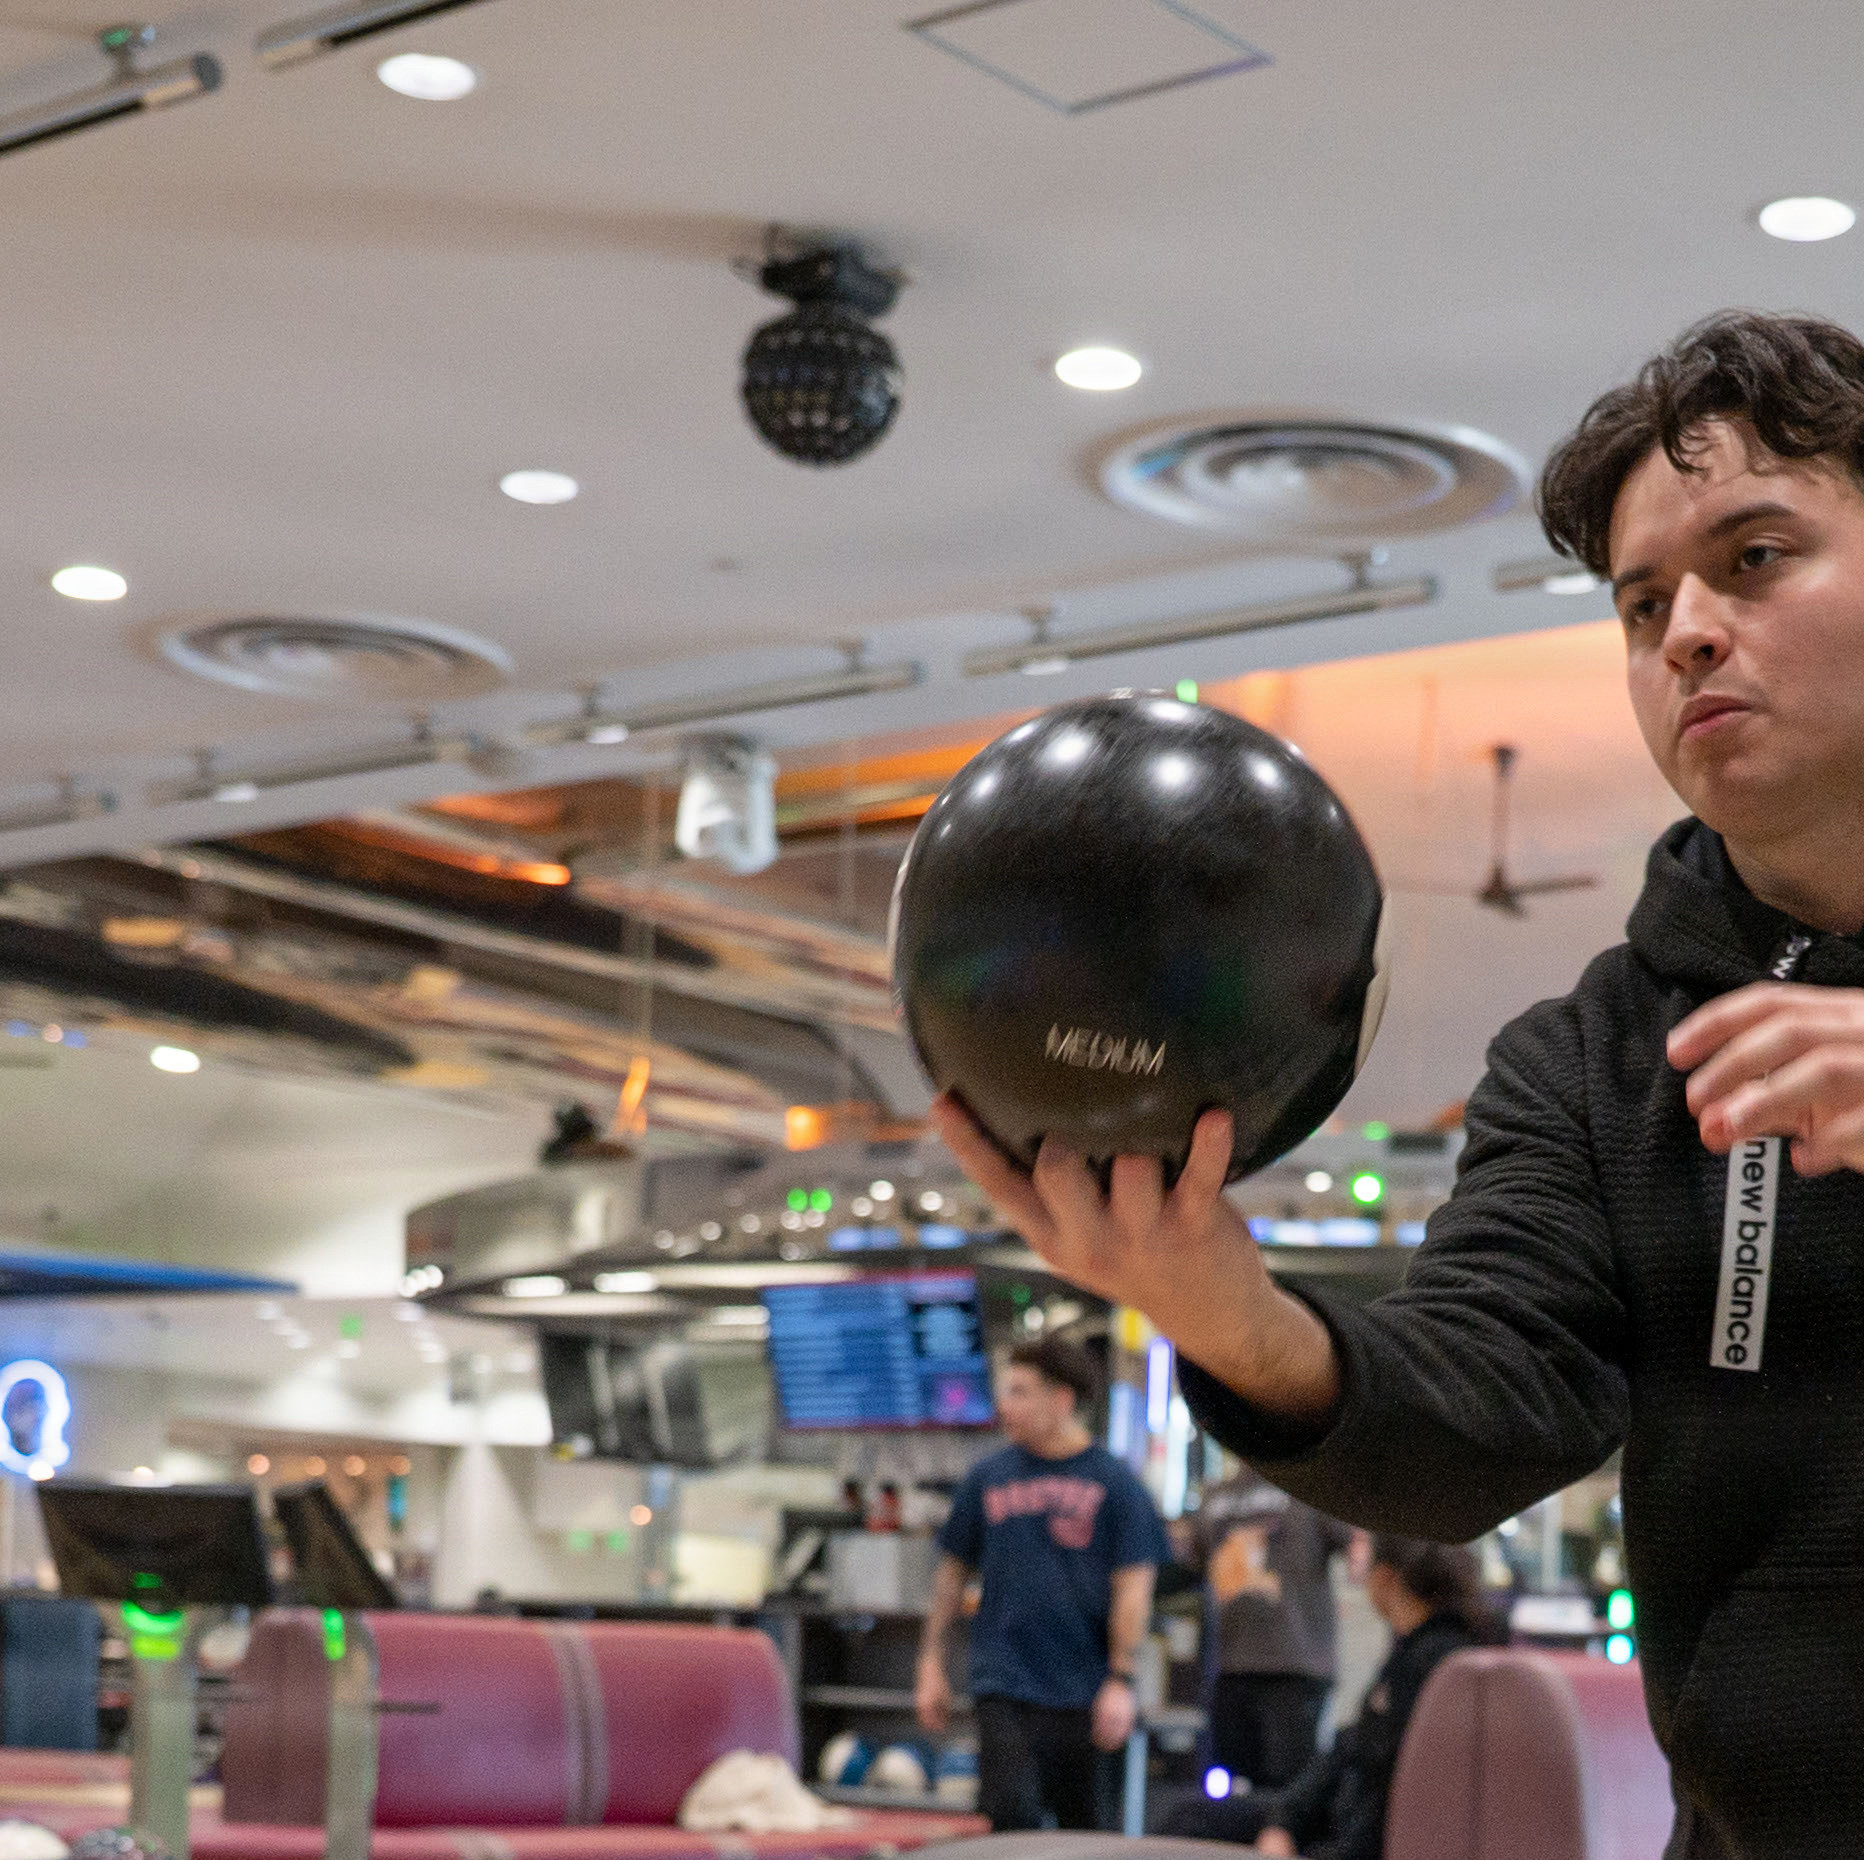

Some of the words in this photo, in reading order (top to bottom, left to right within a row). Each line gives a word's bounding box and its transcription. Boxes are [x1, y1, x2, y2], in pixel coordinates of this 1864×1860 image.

[1044, 1022, 1167, 1077] MEDIUM
[1739, 1139, 1767, 1214] new
[1724, 1217, 1768, 1366] balance
